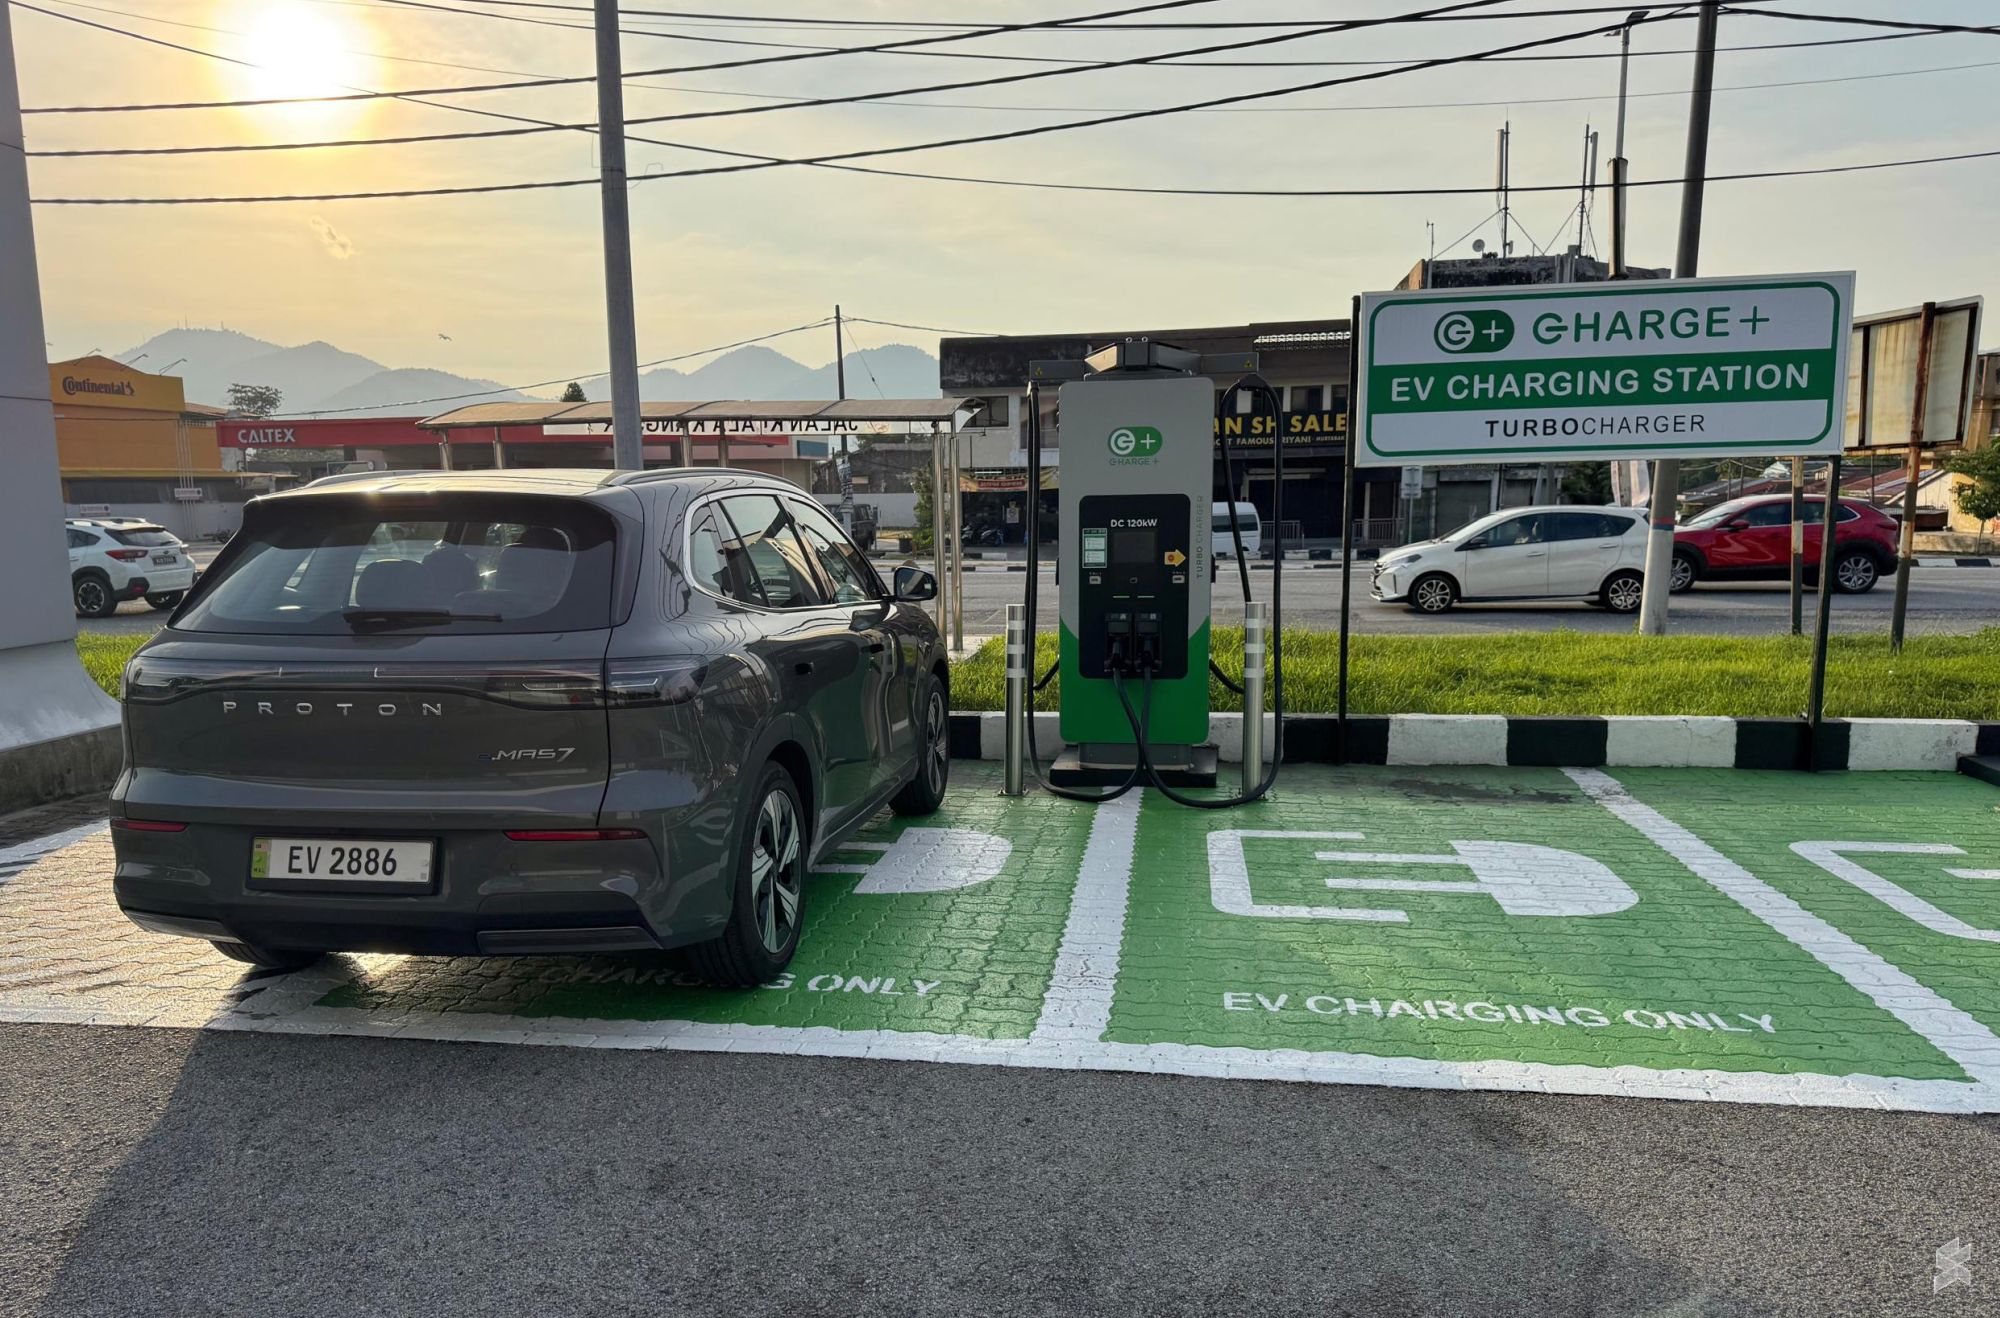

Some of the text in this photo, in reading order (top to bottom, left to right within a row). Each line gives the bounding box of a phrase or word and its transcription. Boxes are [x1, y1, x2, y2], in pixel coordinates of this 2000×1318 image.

[62, 376, 126, 396] Continental
[1391, 363, 1809, 402] EV CHARGING STATION
[238, 428, 295, 443] CALTEX
[1485, 414, 1705, 438] TURBOCHARGER
[1236, 437, 1274, 445] FAMOUS
[1281, 436, 1311, 444] RIYANI
[1110, 518, 1158, 528] DC 120kW
[223, 701, 442, 716] PROTON
[288, 845, 397, 876] EV 2886
[808, 974, 941, 996] ONLY
[1223, 991, 1776, 1033] EV CHARGING ONLY
